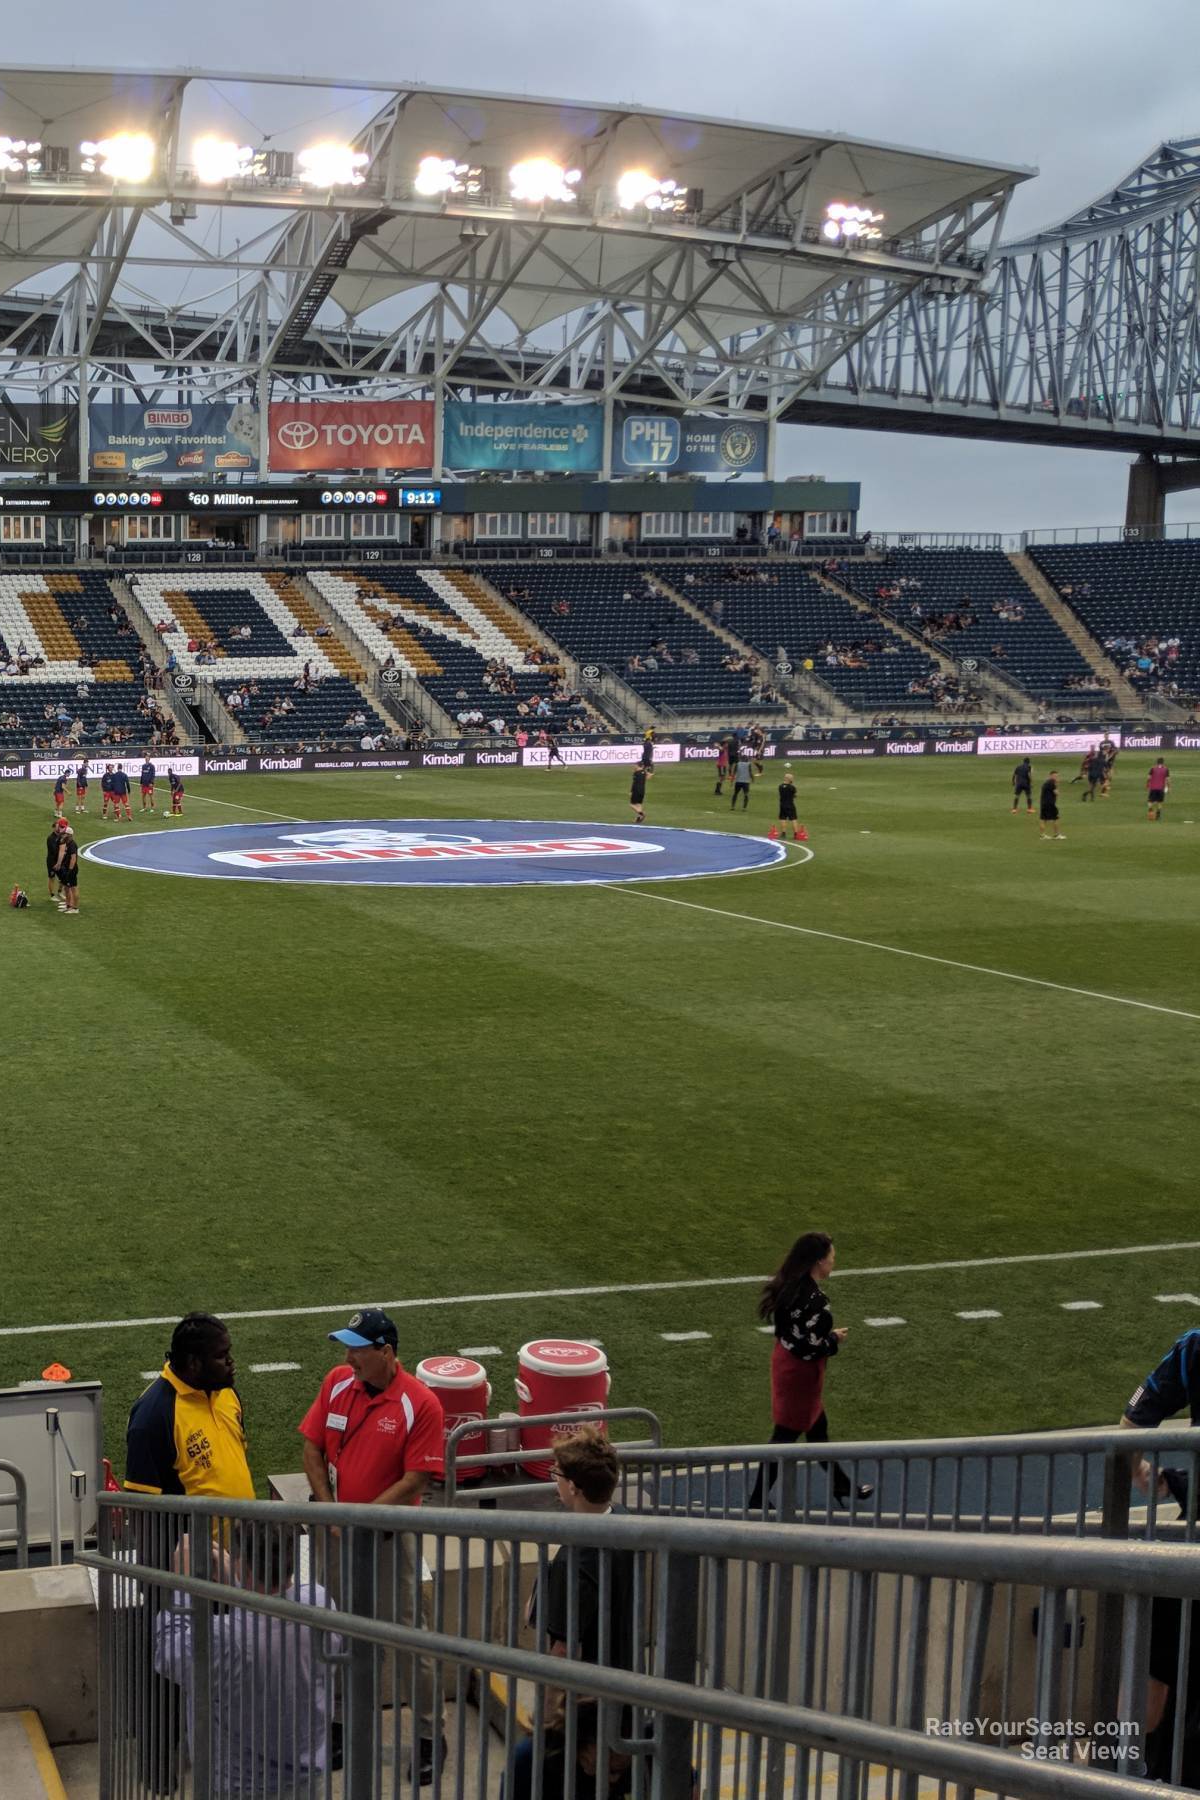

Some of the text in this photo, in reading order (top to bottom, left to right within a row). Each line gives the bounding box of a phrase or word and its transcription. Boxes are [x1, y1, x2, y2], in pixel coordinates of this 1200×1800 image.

[147, 412, 190, 424] BIMBO
[321, 423, 425, 445] TOYOTA
[459, 421, 569, 440] Independence
[631, 421, 673, 441] PHL
[108, 434, 227, 446] Baking your Favorites!
[686, 434, 716, 443] HOME
[651, 442, 673, 461] 17
[686, 445, 716, 453] OF THE
[188, 491, 209, 505] $60
[214, 493, 254, 505] Million
[407, 491, 435, 504] 9:12
[187, 553, 201, 562] 128
[366, 551, 380, 560] 129
[539, 548, 553, 558] 130
[707, 547, 720, 556] 131
[935, 741, 975, 753] Kimball
[1125, 735, 1164, 747] Kimball
[685, 746, 719, 758] Kimba
[886, 742, 926, 754] Kimball
[260, 757, 303, 770] Kimball
[423, 753, 465, 765] Kimball
[476, 751, 519, 764] Kimball
[205, 759, 248, 771] Kimball
[242, 842, 630, 864] BIMBO
[187, 1437, 210, 1458] 6345
